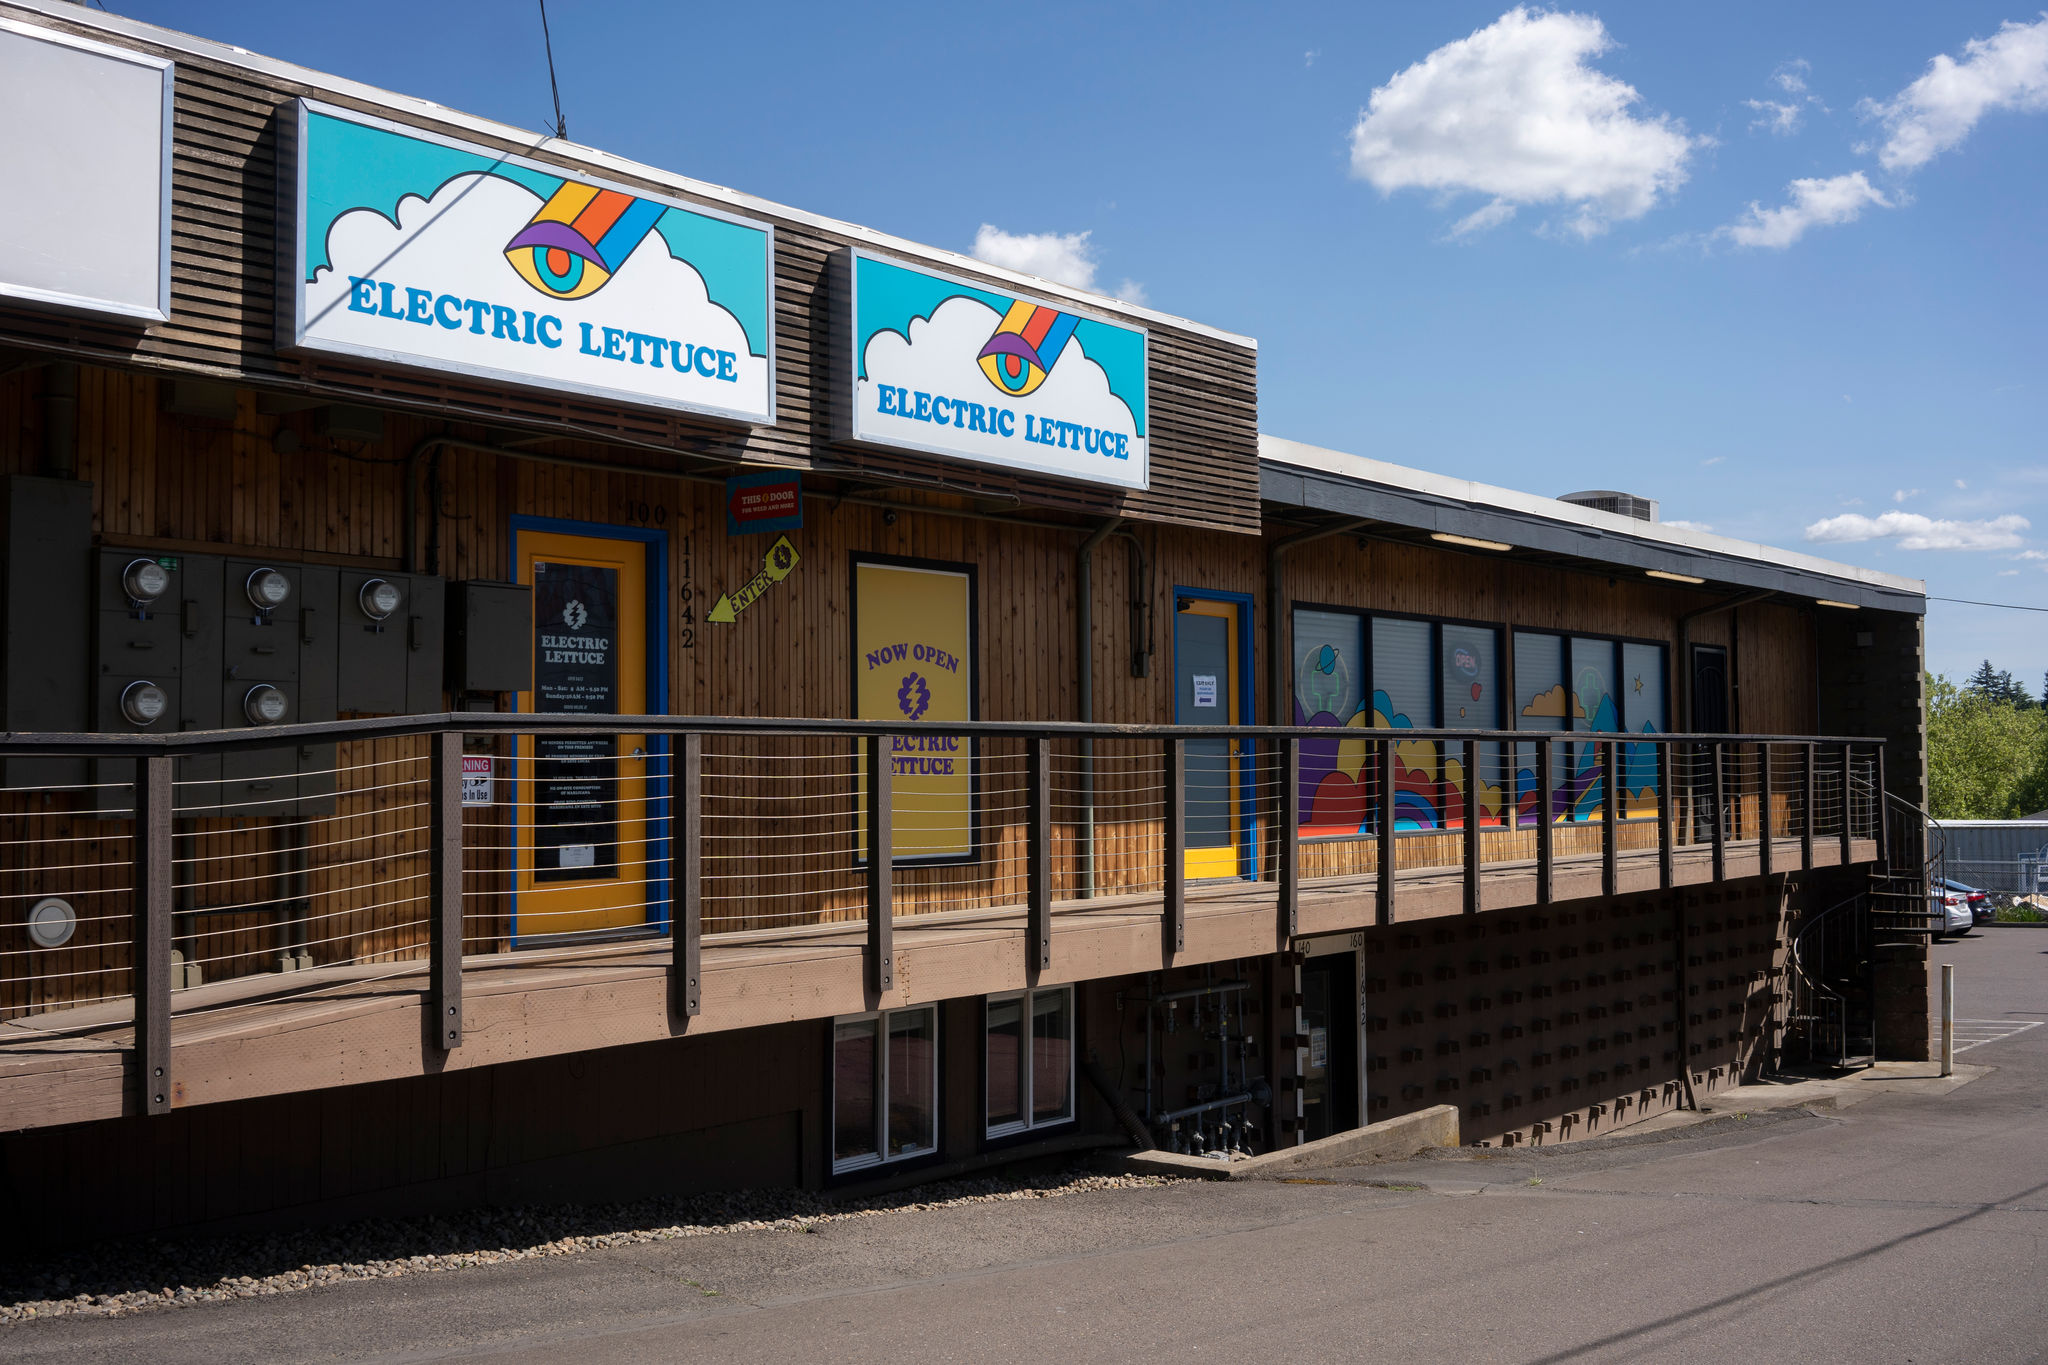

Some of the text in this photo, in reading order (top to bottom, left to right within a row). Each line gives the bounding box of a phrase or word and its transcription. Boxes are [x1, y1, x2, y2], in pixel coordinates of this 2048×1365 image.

[347, 275, 739, 383] ELECTRIC LETTUCE
[877, 383, 1129, 460] ELECTRIC LETTUCE
[741, 491, 794, 505] THIS DOOR
[628, 501, 666, 525] 100
[752, 505, 767, 513] WEED
[780, 502, 795, 510] MORE
[681, 535, 694, 649] 11642
[729, 569, 774, 614] ENTER
[541, 635, 609, 650] ELECTRIC
[545, 650, 605, 665] LETTUCE
[865, 643, 960, 674] NOW OPEN
[1455, 653, 1476, 668] OPEN
[892, 736, 959, 751] ECTRIC
[463, 759, 489, 771] NING
[469, 789, 476, 800] In
[476, 789, 488, 800] Use
[1350, 933, 1363, 948] 160
